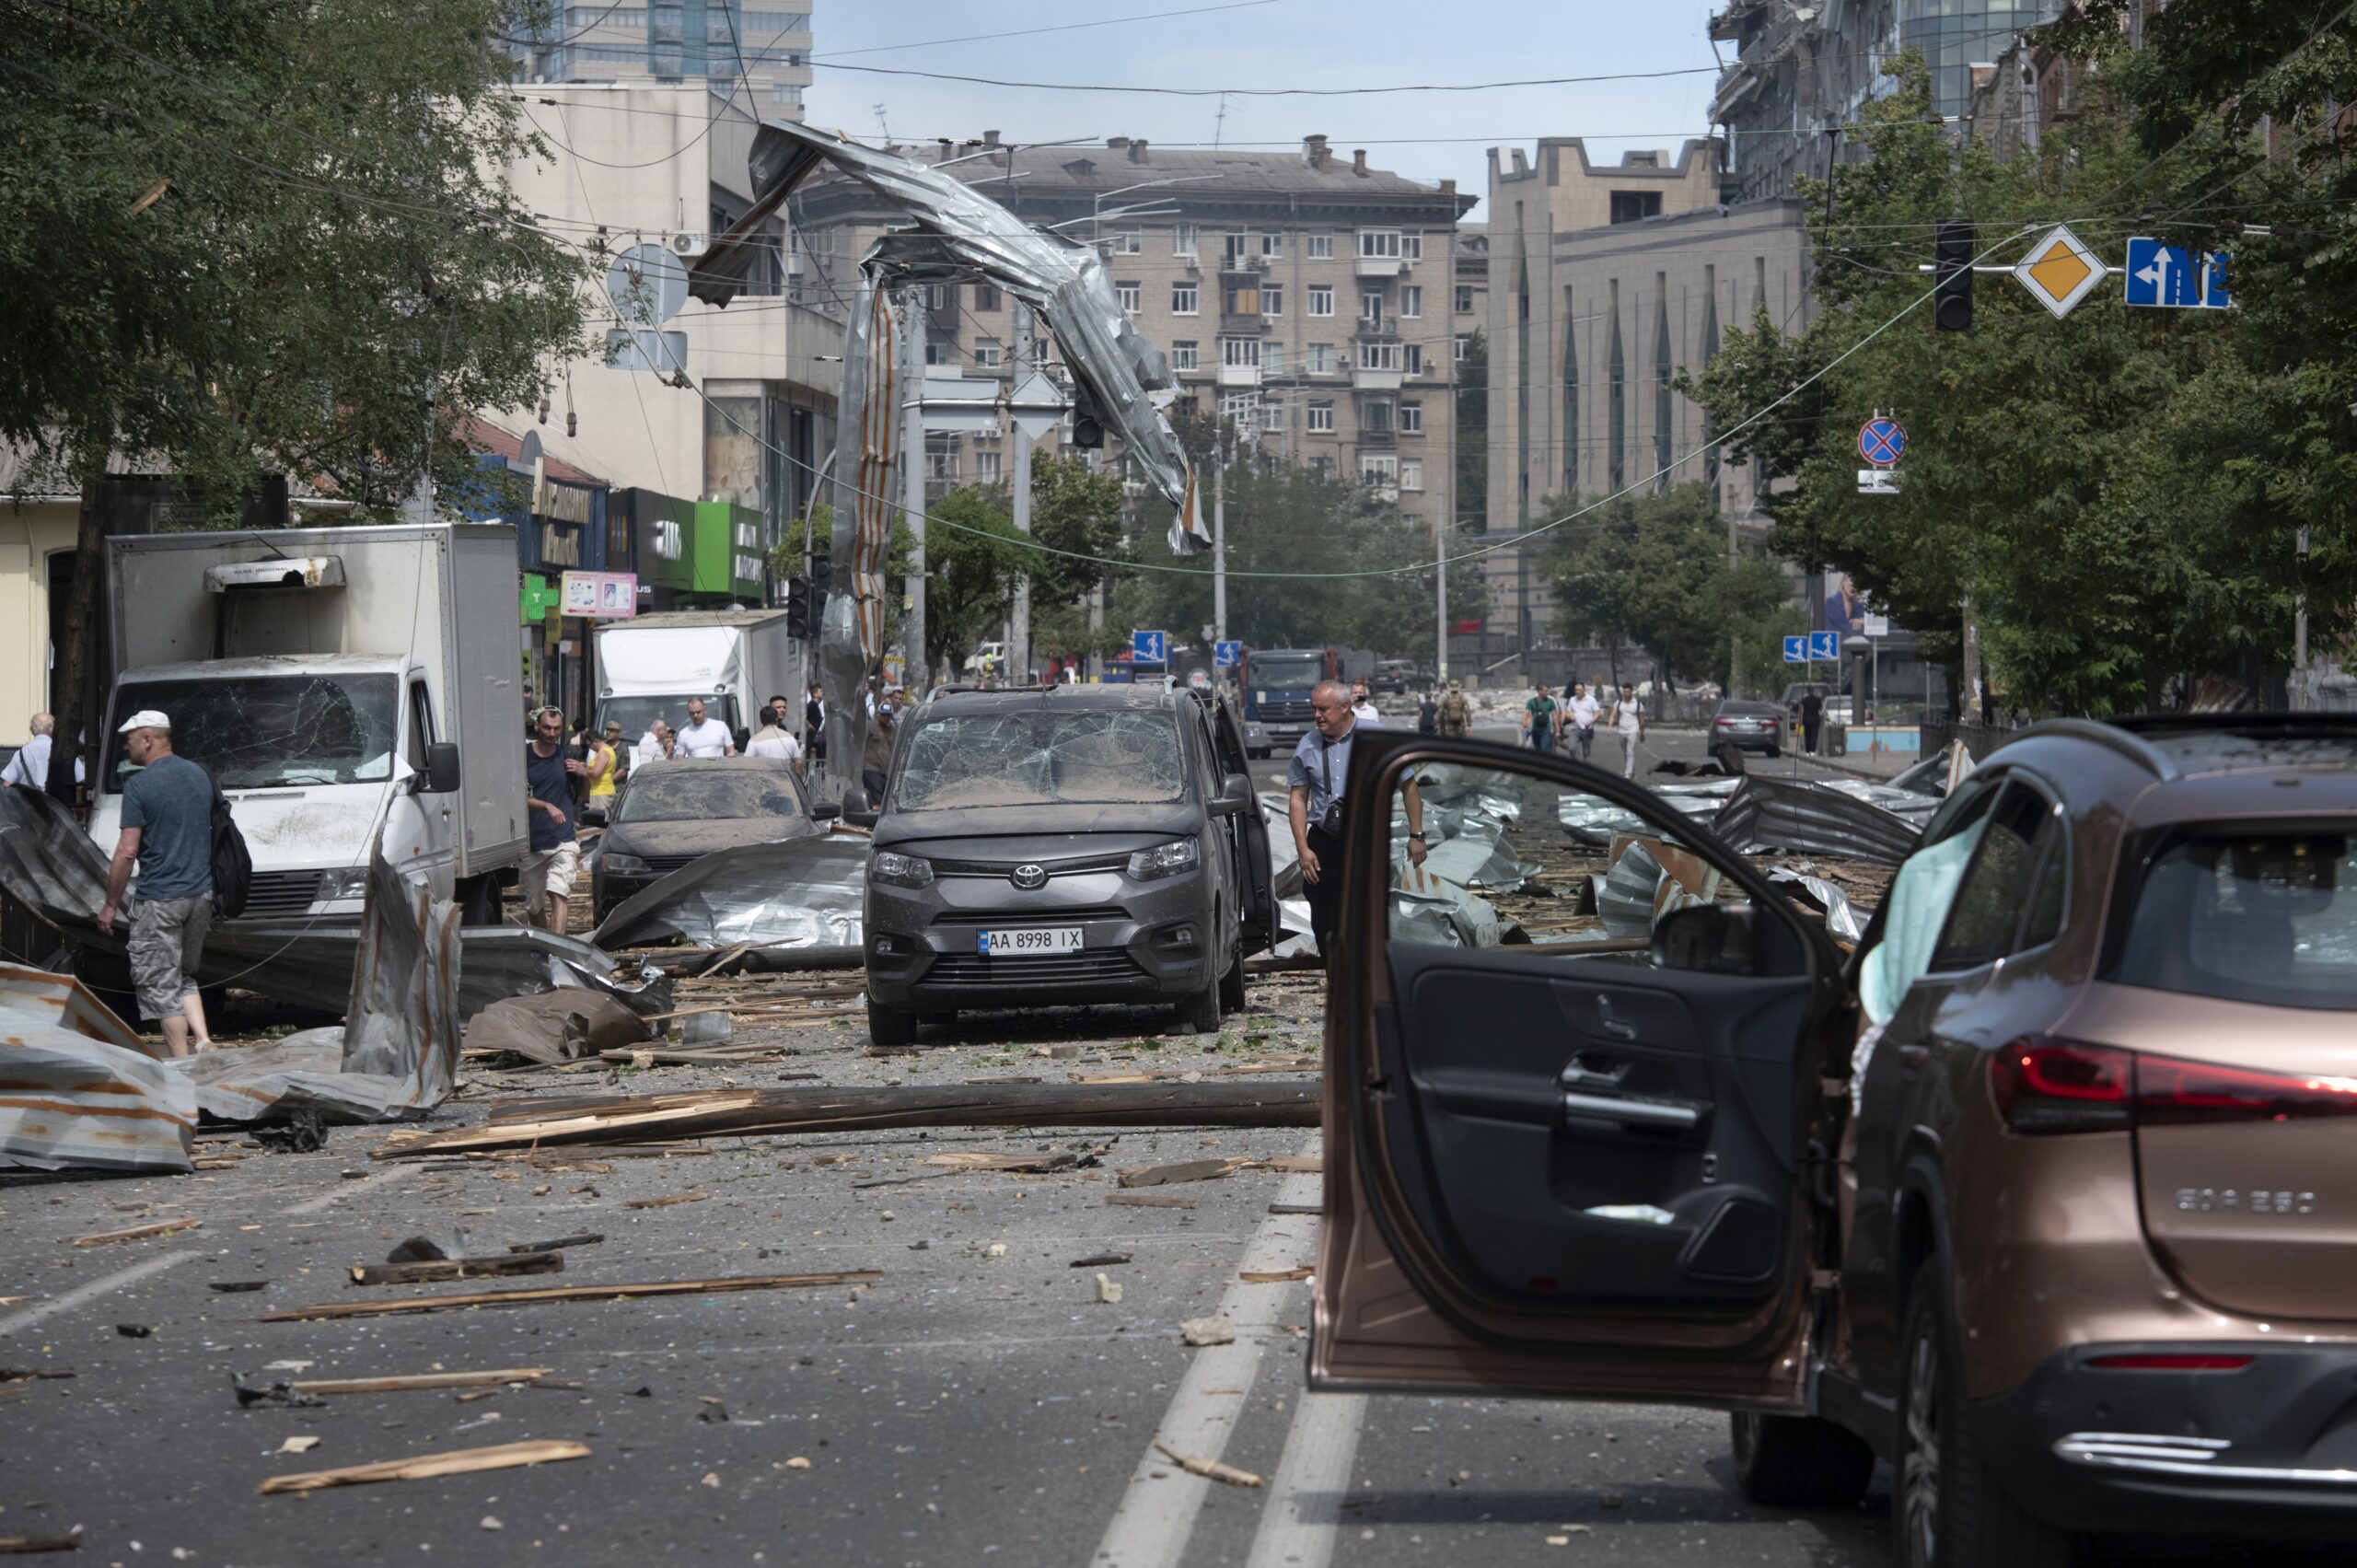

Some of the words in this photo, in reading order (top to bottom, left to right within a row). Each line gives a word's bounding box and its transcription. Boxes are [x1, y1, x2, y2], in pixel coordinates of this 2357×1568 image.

[989, 934, 1010, 949] AA
[1016, 932, 1052, 947] 8998
[1062, 931, 1080, 947] IX
